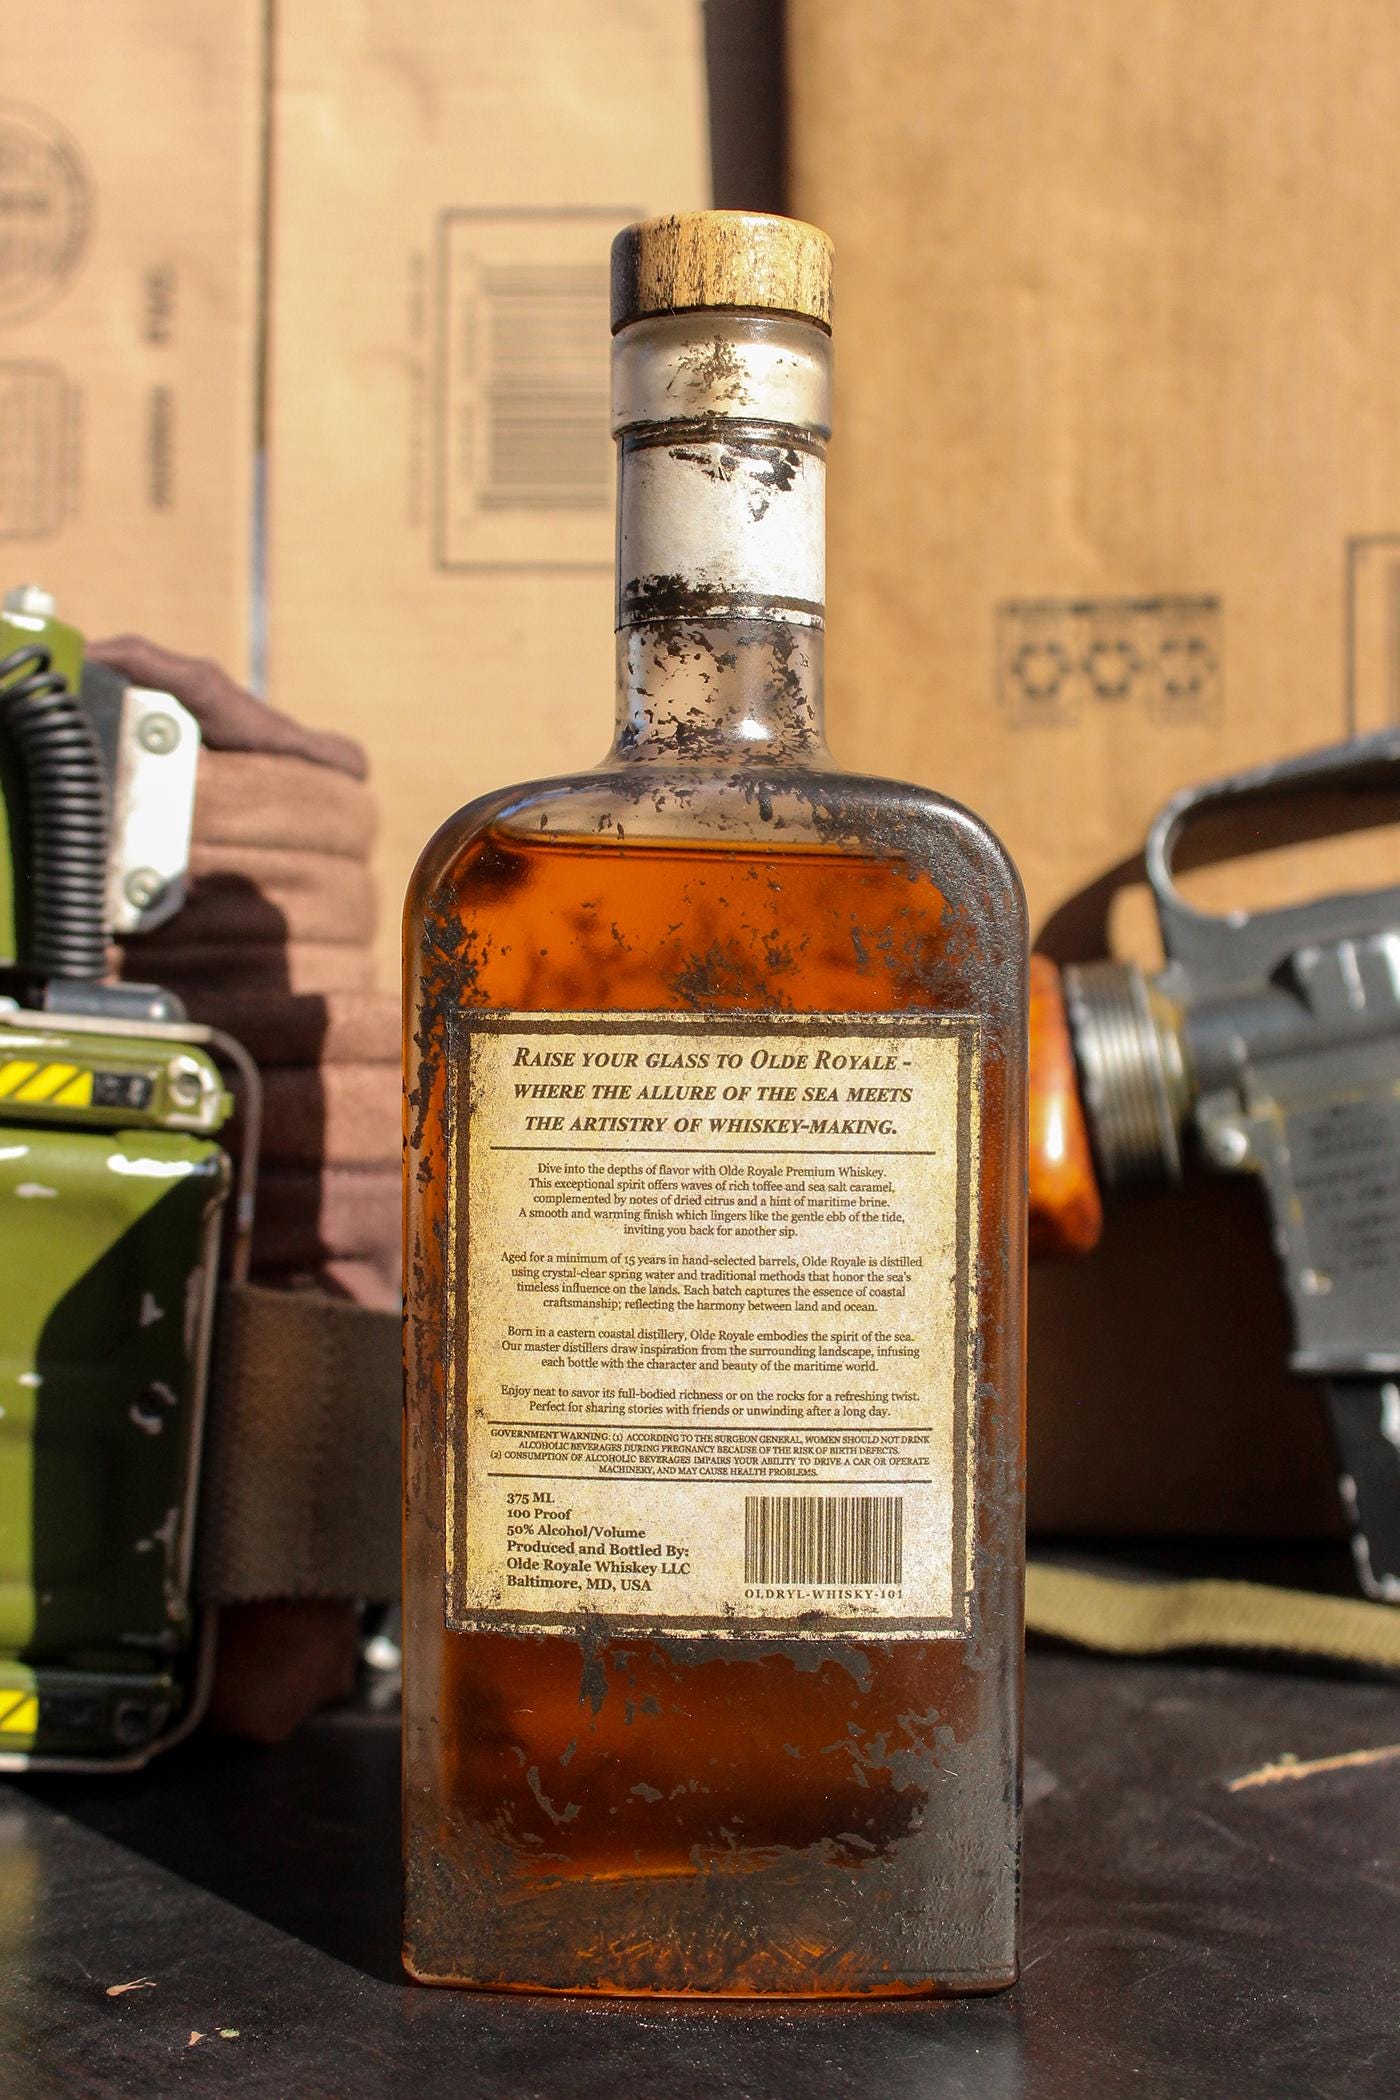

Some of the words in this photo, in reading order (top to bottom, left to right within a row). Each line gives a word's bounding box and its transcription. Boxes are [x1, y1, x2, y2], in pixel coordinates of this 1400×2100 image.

[512, 1047, 575, 1066] RAISE
[582, 1052, 638, 1067] YOUR
[645, 1053, 709, 1068] GLASS
[717, 1054, 742, 1068] TO
[750, 1049, 808, 1069] OLDE
[813, 1049, 897, 1070] ROYALE
[514, 1084, 585, 1099] WHERE
[592, 1084, 632, 1099] THE
[636, 1085, 716, 1100] ALLURE
[722, 1086, 751, 1100] OF
[757, 1086, 797, 1101] THE
[802, 1087, 838, 1101] SEA
[846, 1087, 913, 1102] MEETS
[525, 1116, 564, 1130] THE
[569, 1116, 668, 1131] ARTISTRY
[673, 1117, 702, 1132] OF
[709, 1118, 896, 1134] WHISKEY-MAKING.
[538, 1162, 562, 1173] Dive
[564, 1163, 585, 1174] into
[587, 1163, 604, 1174] the
[607, 1163, 643, 1177] depths
[645, 1164, 657, 1174] of
[659, 1164, 690, 1175] flavor
[692, 1164, 716, 1175] with
[718, 1165, 744, 1176] Olde
[747, 1165, 783, 1178] Royale
[786, 1166, 835, 1176] Premium
[838, 1166, 886, 1179] Whiskey.
[623, 1223, 664, 1237] inviting
[666, 1227, 686, 1237] you
[689, 1224, 714, 1235] back
[716, 1224, 732, 1235] for
[734, 1225, 776, 1236] another
[778, 1225, 797, 1239] sip.
[501, 1251, 526, 1264] Aged
[529, 1251, 545, 1262] for
[556, 1252, 607, 1263] minimum
[610, 1253, 622, 1264] of
[624, 1255, 635, 1266] 15
[637, 1256, 666, 1266] years
[668, 1254, 679, 1264] in
[682, 1254, 755, 1265] hand-selected
[758, 1255, 799, 1267] barrels,
[802, 1255, 827, 1266] Olde
[830, 1256, 866, 1269] Royale
[868, 1256, 877, 1266] is
[879, 1256, 922, 1267] distilled
[516, 1281, 559, 1292] timeless
[561, 1282, 610, 1293] influence
[612, 1286, 626, 1294] on
[629, 1283, 646, 1294] the
[648, 1283, 680, 1294] lands.
[683, 1284, 709, 1295] Each
[712, 1284, 741, 1295] batch
[744, 1287, 790, 1298] captures
[793, 1285, 810, 1296] the
[812, 1288, 853, 1297] essence
[855, 1286, 867, 1296] of
[868, 1286, 905, 1297] coastal
[543, 1297, 621, 1311] craftsmanship;
[624, 1298, 674, 1311] reflecting
[677, 1299, 694, 1309] the
[697, 1299, 745, 1313] harmony
[747, 1300, 791, 1311] between
[795, 1300, 818, 1311] land
[821, 1300, 841, 1311] and
[843, 1303, 877, 1311] ocean.
[508, 1325, 533, 1337] Born
[535, 1326, 545, 1336] in
[548, 1329, 554, 1337] a
[556, 1328, 595, 1338] eastern
[598, 1328, 635, 1338] coastal
[637, 1328, 687, 1342] distillery,
[690, 1329, 715, 1340] Olde
[718, 1329, 754, 1343] Royale
[756, 1330, 808, 1341] embodies
[811, 1330, 828, 1341] the
[830, 1331, 858, 1344] spirit
[861, 1331, 873, 1341] of
[874, 1330, 891, 1341] the
[894, 1333, 914, 1341] sea.
[541, 1356, 565, 1367] each
[567, 1356, 598, 1368] bottle
[600, 1357, 624, 1368] with
[626, 1357, 644, 1368] the
[646, 1358, 696, 1370] character
[698, 1359, 719, 1370] and
[721, 1359, 757, 1372] beauty
[760, 1360, 772, 1370] of
[773, 1360, 790, 1371] the
[793, 1361, 842, 1371] maritime
[845, 1360, 878, 1371] world.
[529, 1400, 565, 1412] Perfect
[568, 1401, 583, 1412] for
[585, 1401, 625, 1415] sharing
[628, 1404, 663, 1414] stories
[665, 1403, 689, 1414] with
[692, 1404, 729, 1415] friends
[731, 1407, 744, 1415] or
[746, 1404, 804, 1418] unwinding
[806, 1405, 831, 1416] after
[833, 1408, 840, 1416] a
[842, 1405, 866, 1419] long
[868, 1405, 890, 1418] day.
[491, 1429, 558, 1439] GOVERNMENT
[626, 1431, 679, 1441] ACCORDING
[681, 1432, 693, 1441] TO
[695, 1432, 713, 1442] THE
[714, 1432, 758, 1442] SURGEON
[805, 1434, 841, 1443] WOMEN
[842, 1434, 880, 1444] SHOULD
[881, 1435, 899, 1444] NOT
[901, 1435, 930, 1445] DRINK
[504, 1451, 568, 1461] CONSUMPTION
[570, 1453, 583, 1461] OF
[584, 1454, 636, 1462] ALCOHOLIC
[814, 1457, 841, 1465] DRIVE
[853, 1457, 871, 1465] CAR
[873, 1457, 886, 1465] OR
[889, 1457, 929, 1465] OPERATE
[506, 1493, 529, 1504] 375
[532, 1492, 554, 1503] ML
[507, 1509, 530, 1518] 100
[534, 1508, 572, 1520] Proof
[506, 1524, 534, 1535] 50%
[537, 1524, 645, 1539] Alcohol/Volume
[507, 1540, 574, 1553] Produced
[578, 1543, 605, 1554] and
[609, 1543, 661, 1556] Bottled
[666, 1545, 689, 1559] By:
[506, 1557, 539, 1570] Olde
[543, 1558, 591, 1573] Royale
[595, 1560, 657, 1576] Whiskey
[661, 1562, 690, 1575] LLC
[506, 1574, 581, 1591] Baltimore,
[586, 1578, 616, 1592] MD,
[620, 1579, 651, 1591] USA
[744, 1589, 901, 1598] OLDRYL-WHISKY-101
